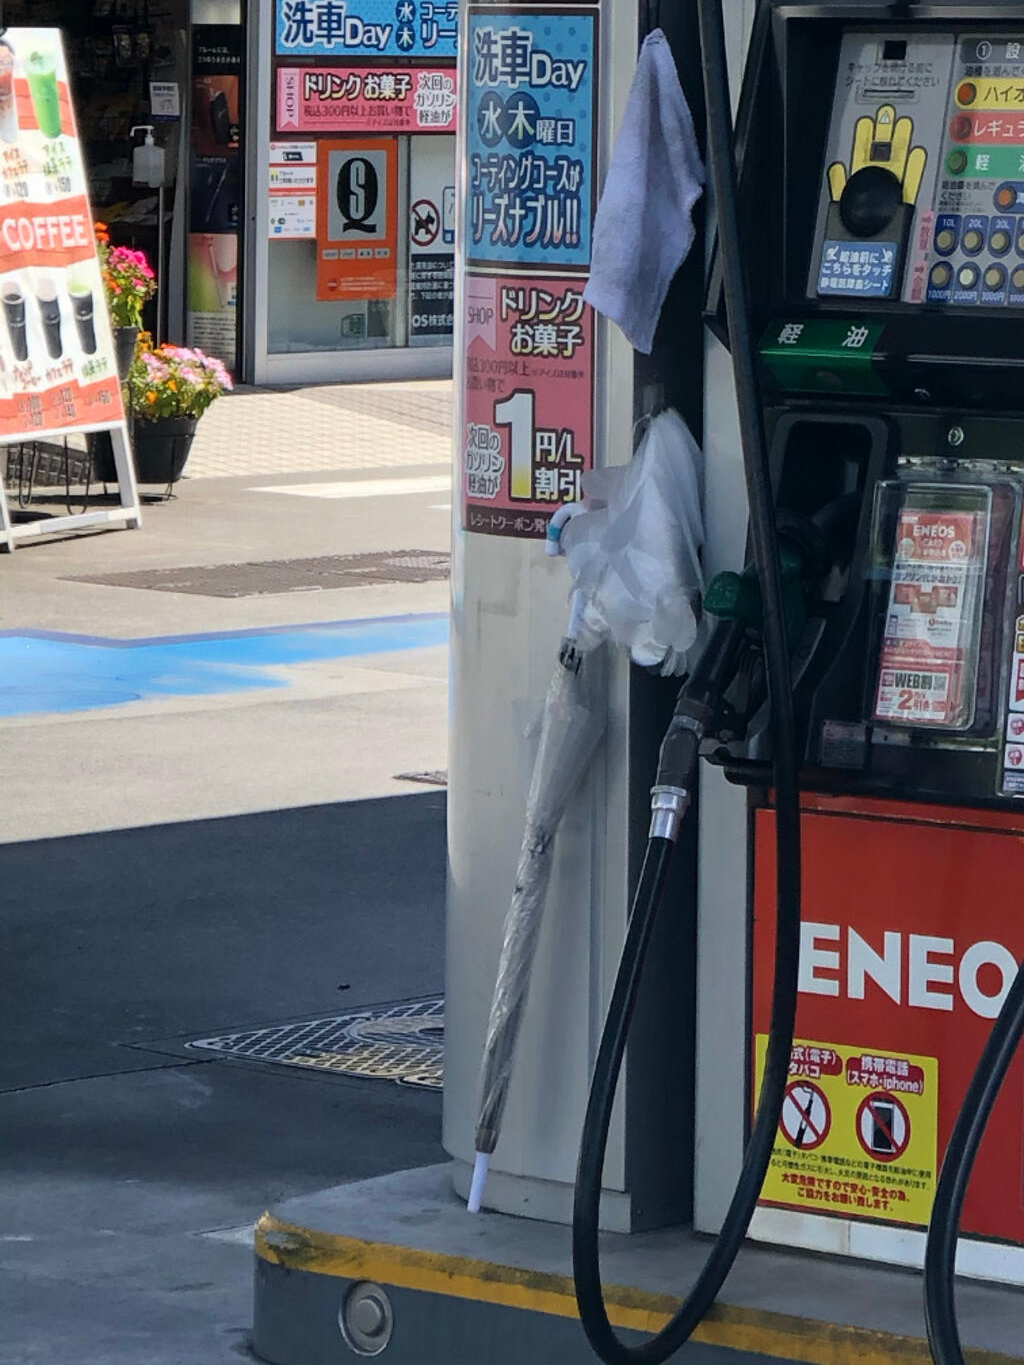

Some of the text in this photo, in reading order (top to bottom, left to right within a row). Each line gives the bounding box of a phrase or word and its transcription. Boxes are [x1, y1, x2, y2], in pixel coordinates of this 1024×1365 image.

[474, 27, 585, 89] 洗車Day
[303, 74, 364, 101] ドリンク
[364, 74, 412, 101] お菓子
[2, 214, 89, 251] COFFEE
[500, 288, 584, 323] ドリンク
[510, 324, 583, 357] お菓子
[861, 1054, 909, 1077] 携帯電話
